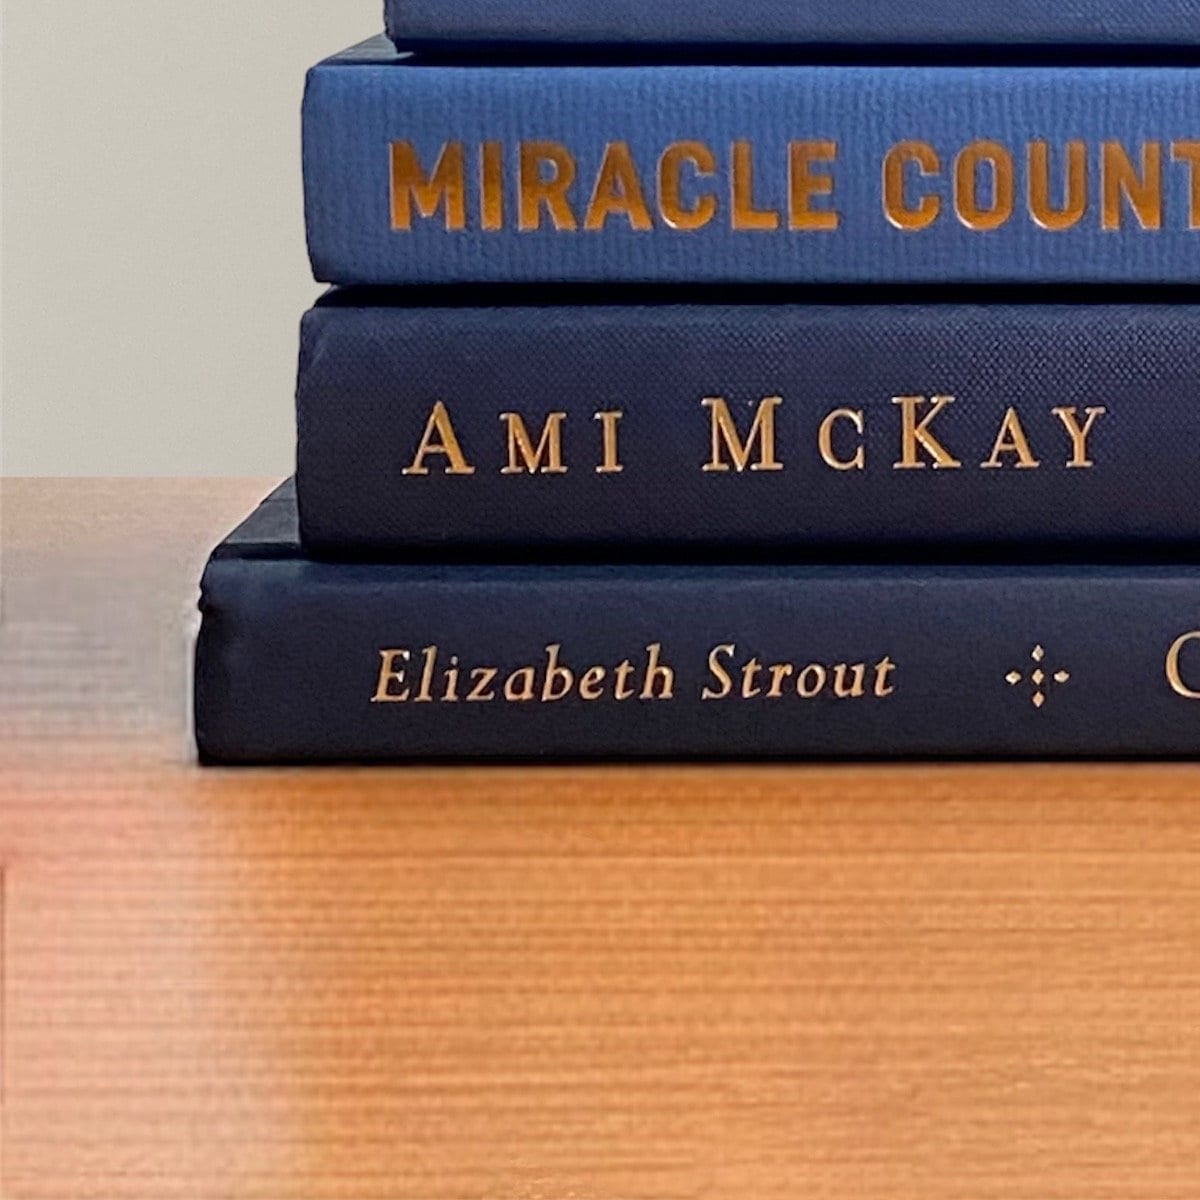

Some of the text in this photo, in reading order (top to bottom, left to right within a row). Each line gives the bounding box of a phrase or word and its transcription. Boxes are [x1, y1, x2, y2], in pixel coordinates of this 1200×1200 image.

[388, 140, 840, 231] MIRACLE
[401, 400, 625, 475] AMI
[370, 642, 897, 703] Elizabeth Strout
